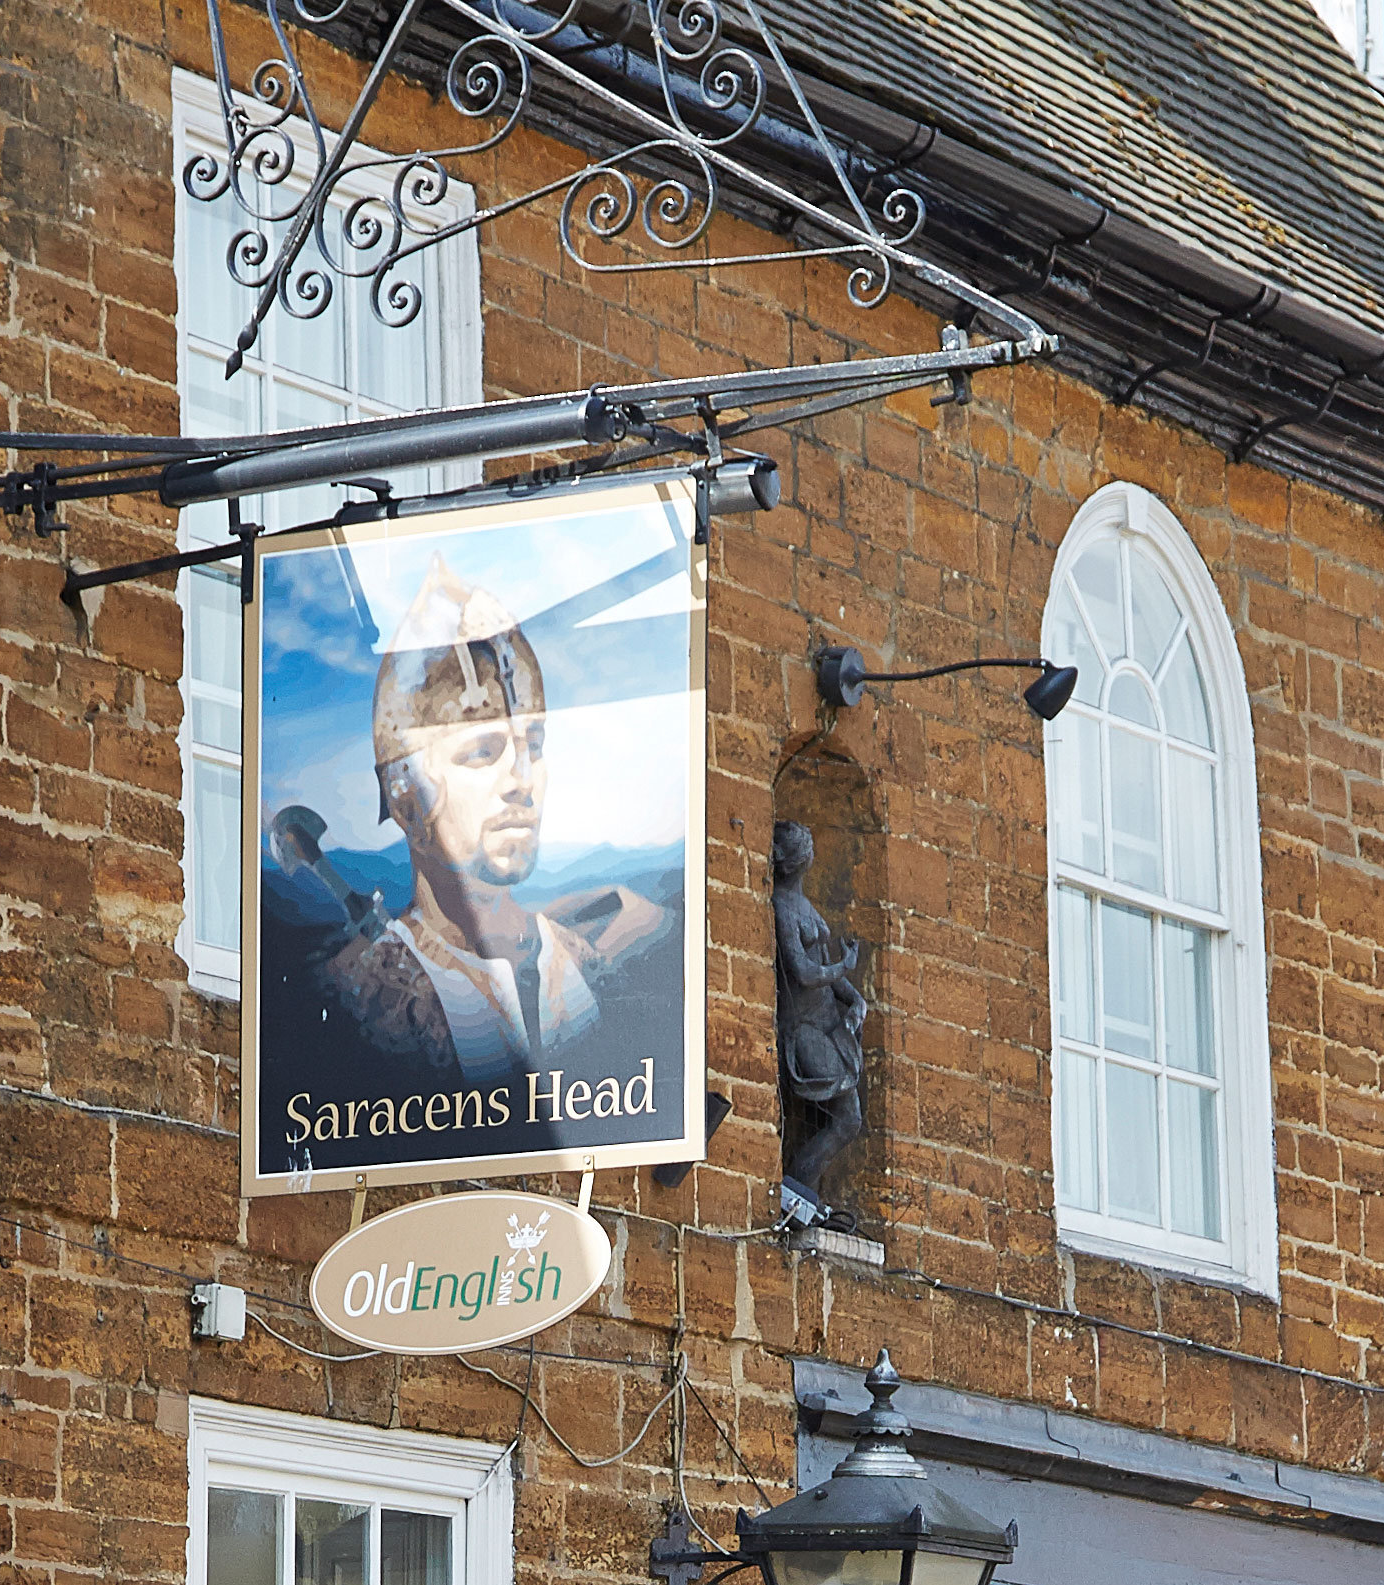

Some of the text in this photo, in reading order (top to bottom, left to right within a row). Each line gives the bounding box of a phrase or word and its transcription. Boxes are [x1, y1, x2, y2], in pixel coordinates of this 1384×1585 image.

[284, 1057, 657, 1145] Saracens Head
[496, 1269, 515, 1306] INNS
